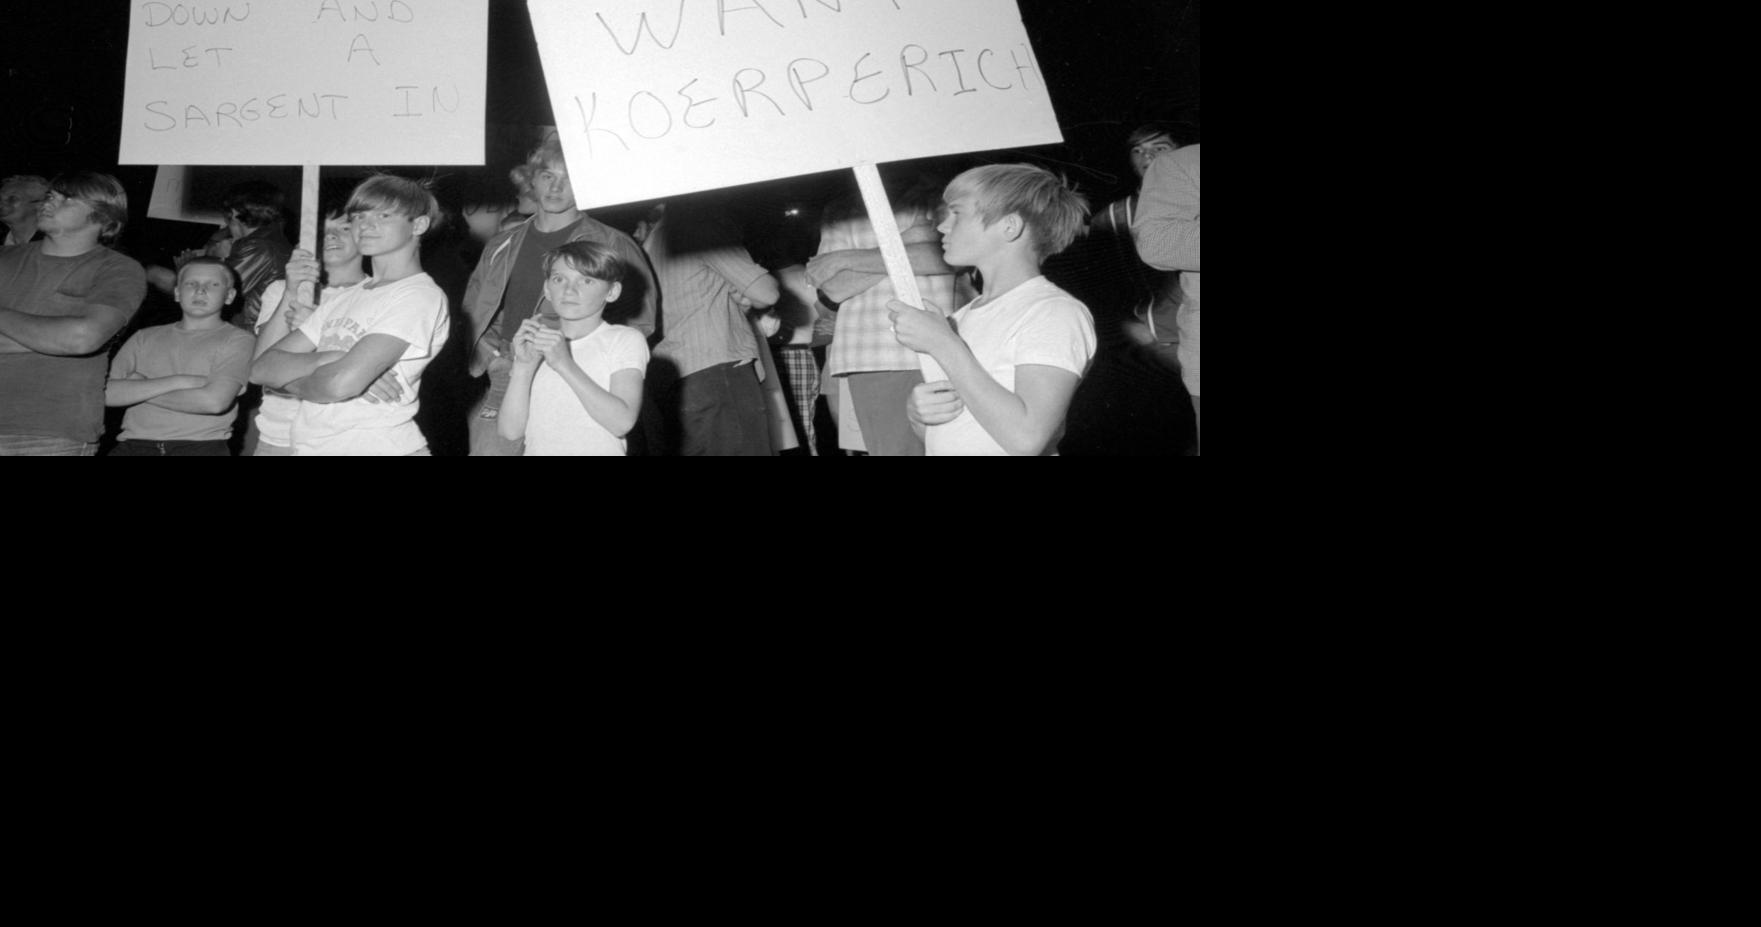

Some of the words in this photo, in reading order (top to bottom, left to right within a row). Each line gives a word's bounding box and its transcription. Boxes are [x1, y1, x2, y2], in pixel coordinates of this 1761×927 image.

[143, 2, 251, 28] DOWN
[314, 0, 414, 24] AND
[150, 45, 233, 70] LET
[347, 33, 380, 66] A
[143, 93, 349, 132] SARGENT
[393, 85, 461, 118] IN
[575, 43, 1043, 158] KOERPERICH
